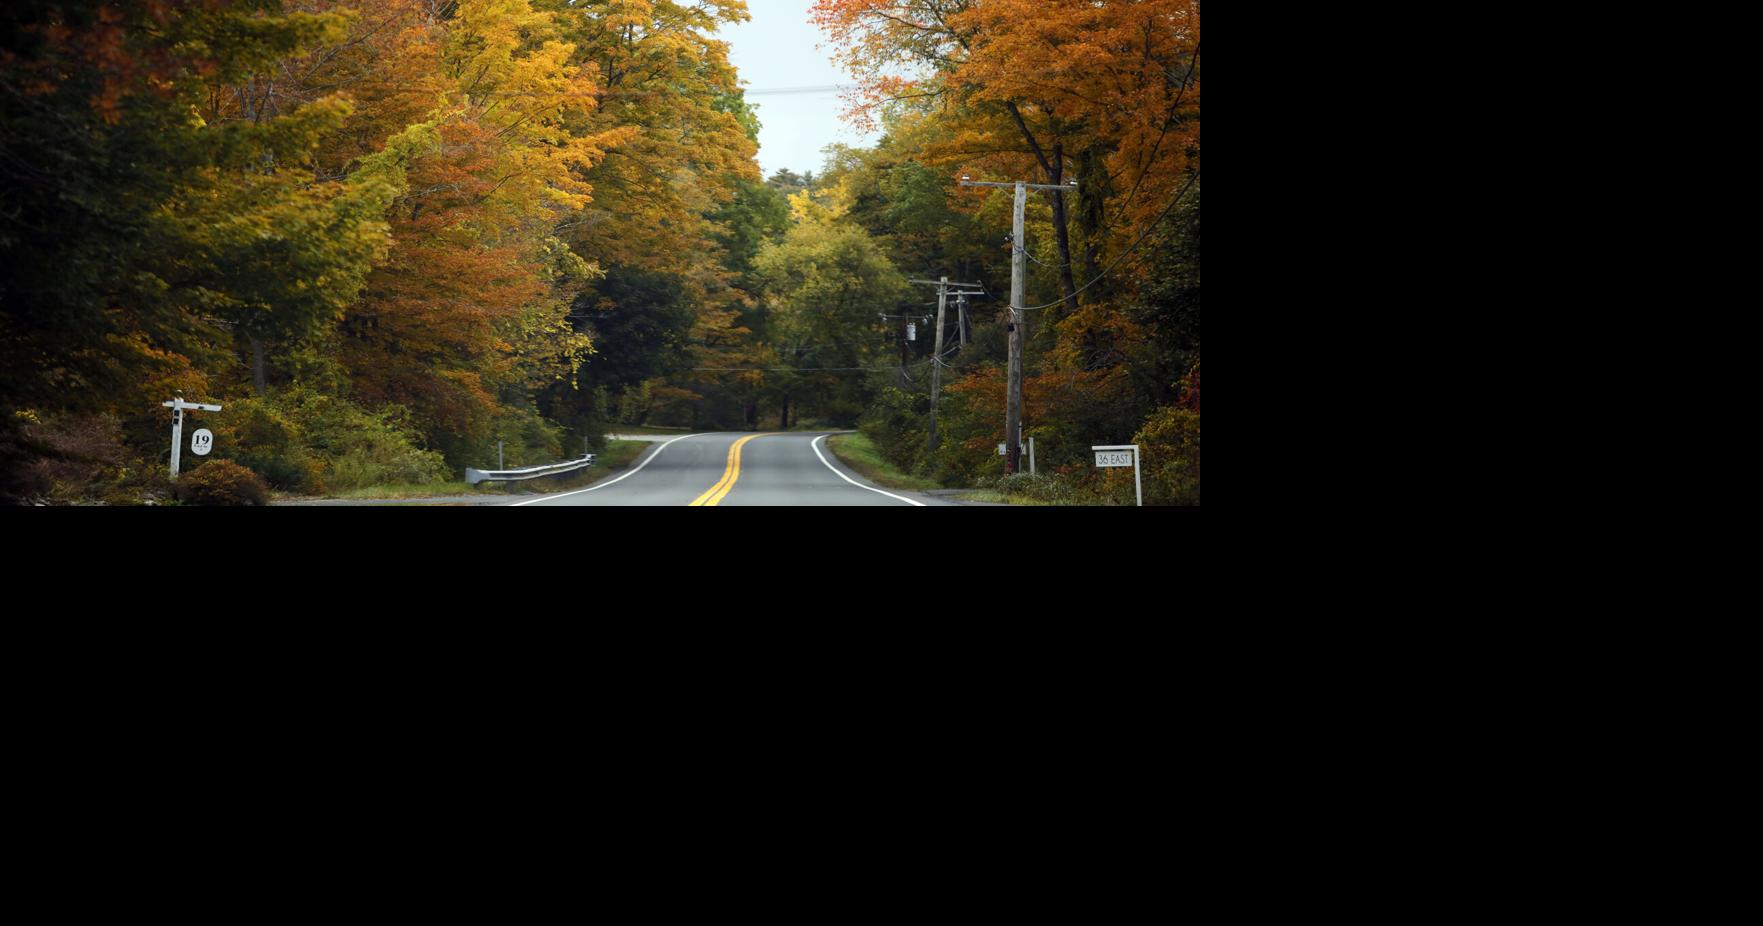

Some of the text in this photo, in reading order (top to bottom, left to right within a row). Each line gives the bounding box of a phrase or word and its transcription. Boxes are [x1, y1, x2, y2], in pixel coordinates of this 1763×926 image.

[195, 435, 210, 445] 19
[1098, 454, 1128, 464] 36 EAST
